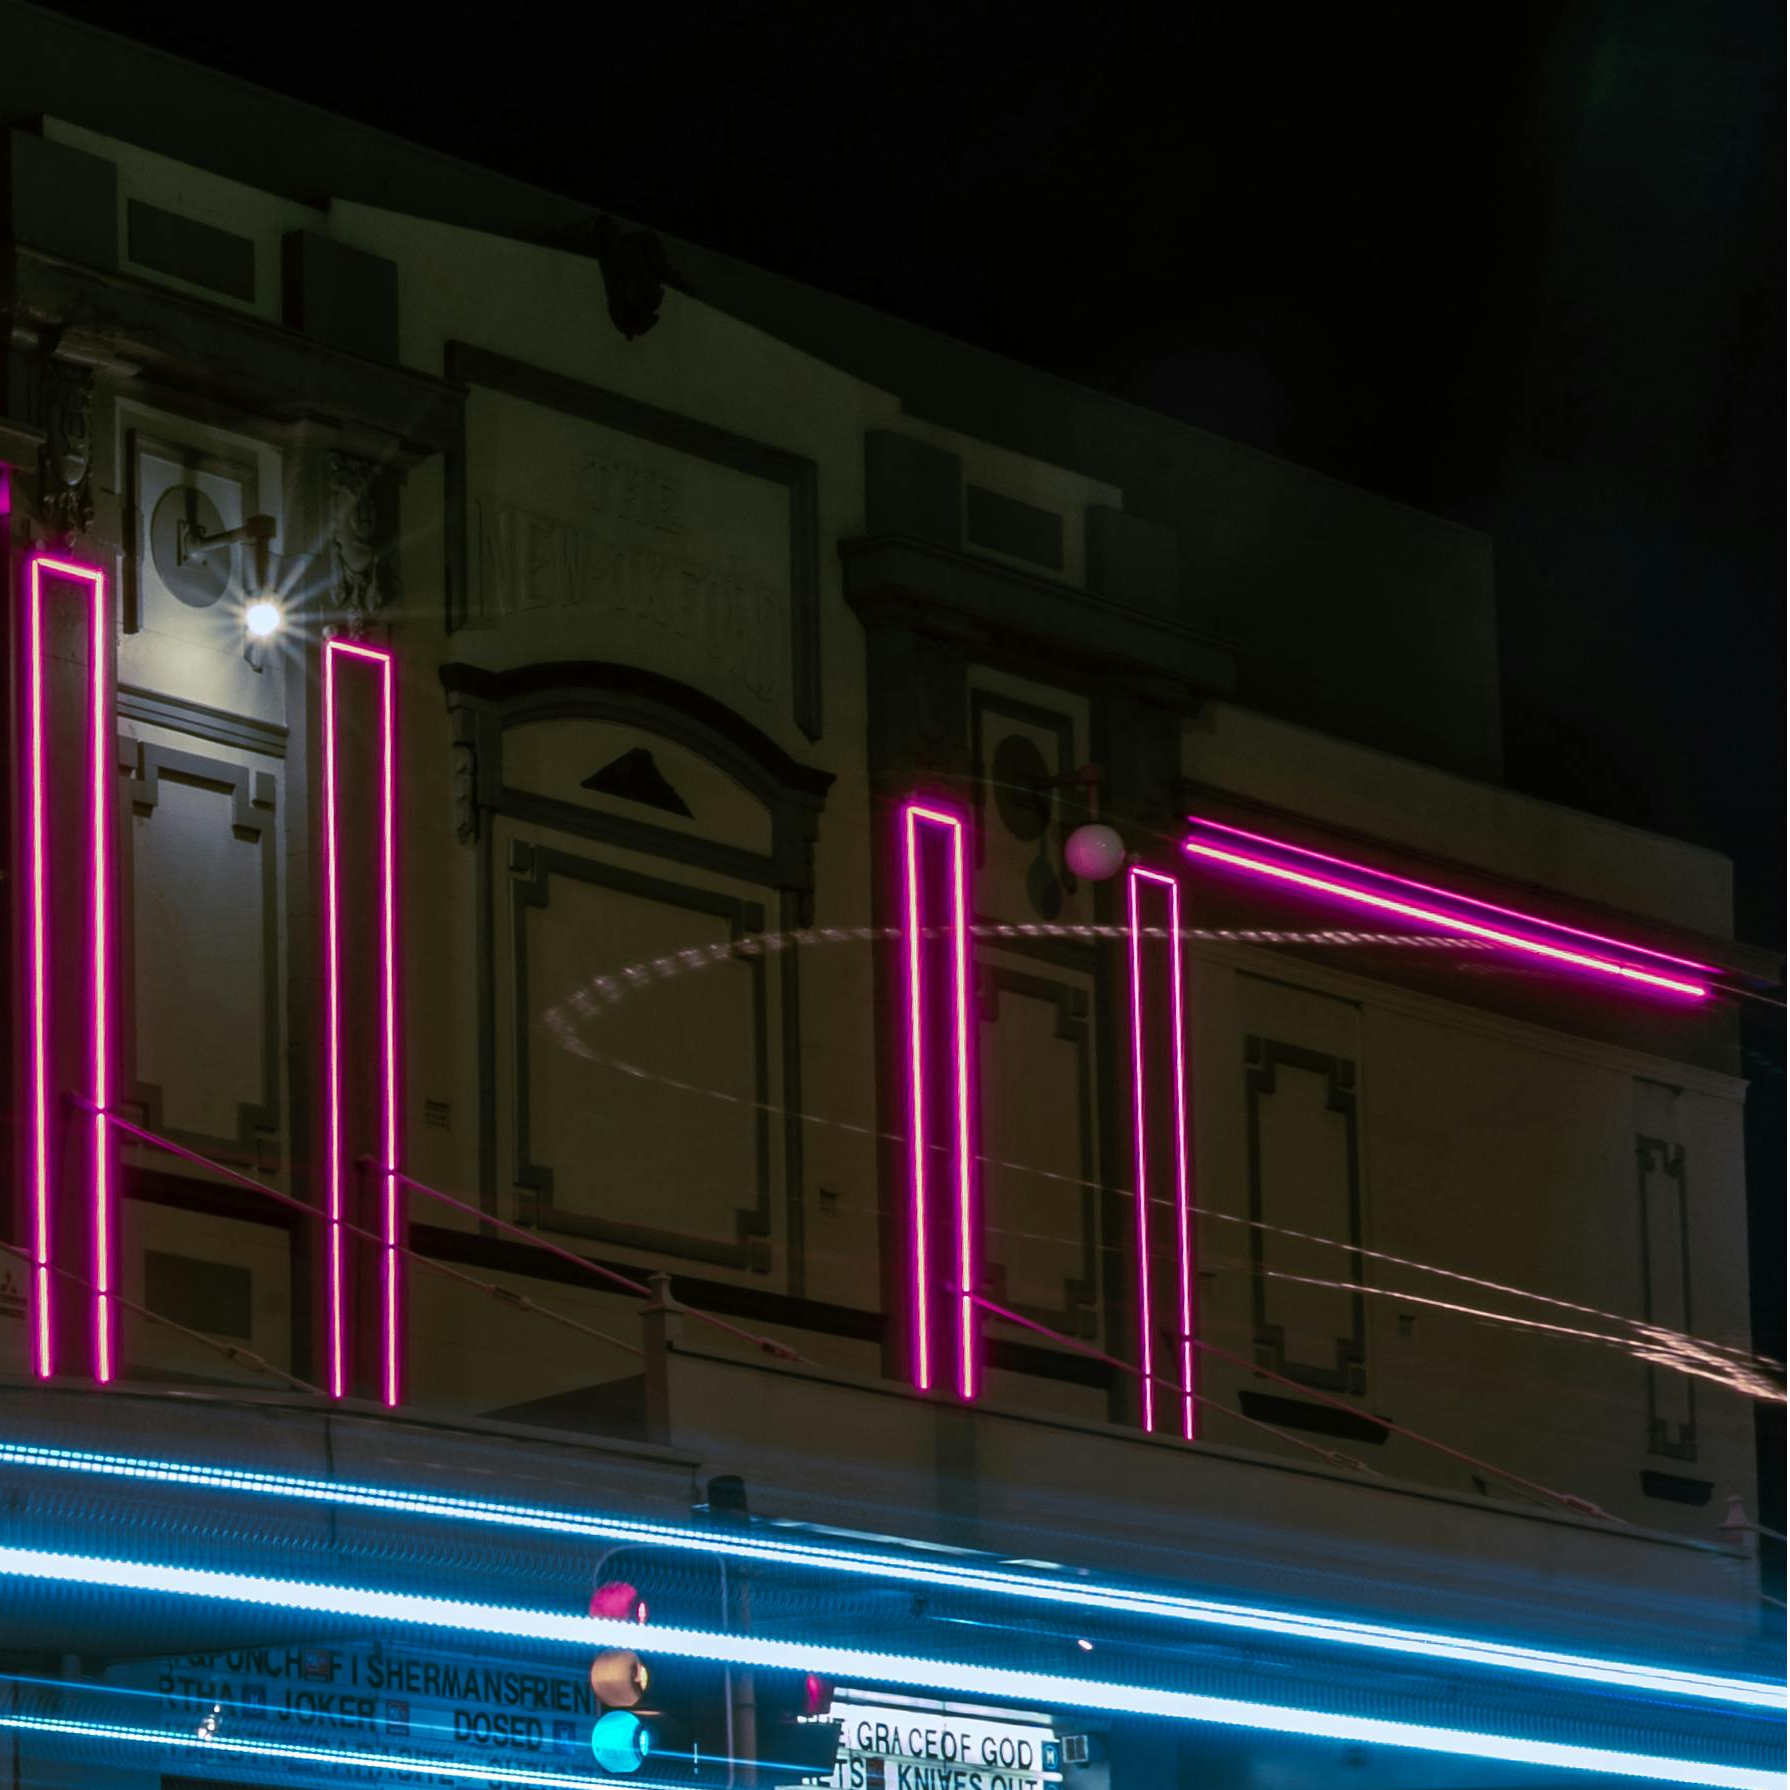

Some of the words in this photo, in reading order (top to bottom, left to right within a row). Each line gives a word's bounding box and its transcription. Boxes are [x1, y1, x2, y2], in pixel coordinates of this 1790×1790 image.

[277, 1687, 377, 1732] JOKER
[455, 1709, 542, 1751] DOSED
[981, 1736, 1034, 1770] GOD
